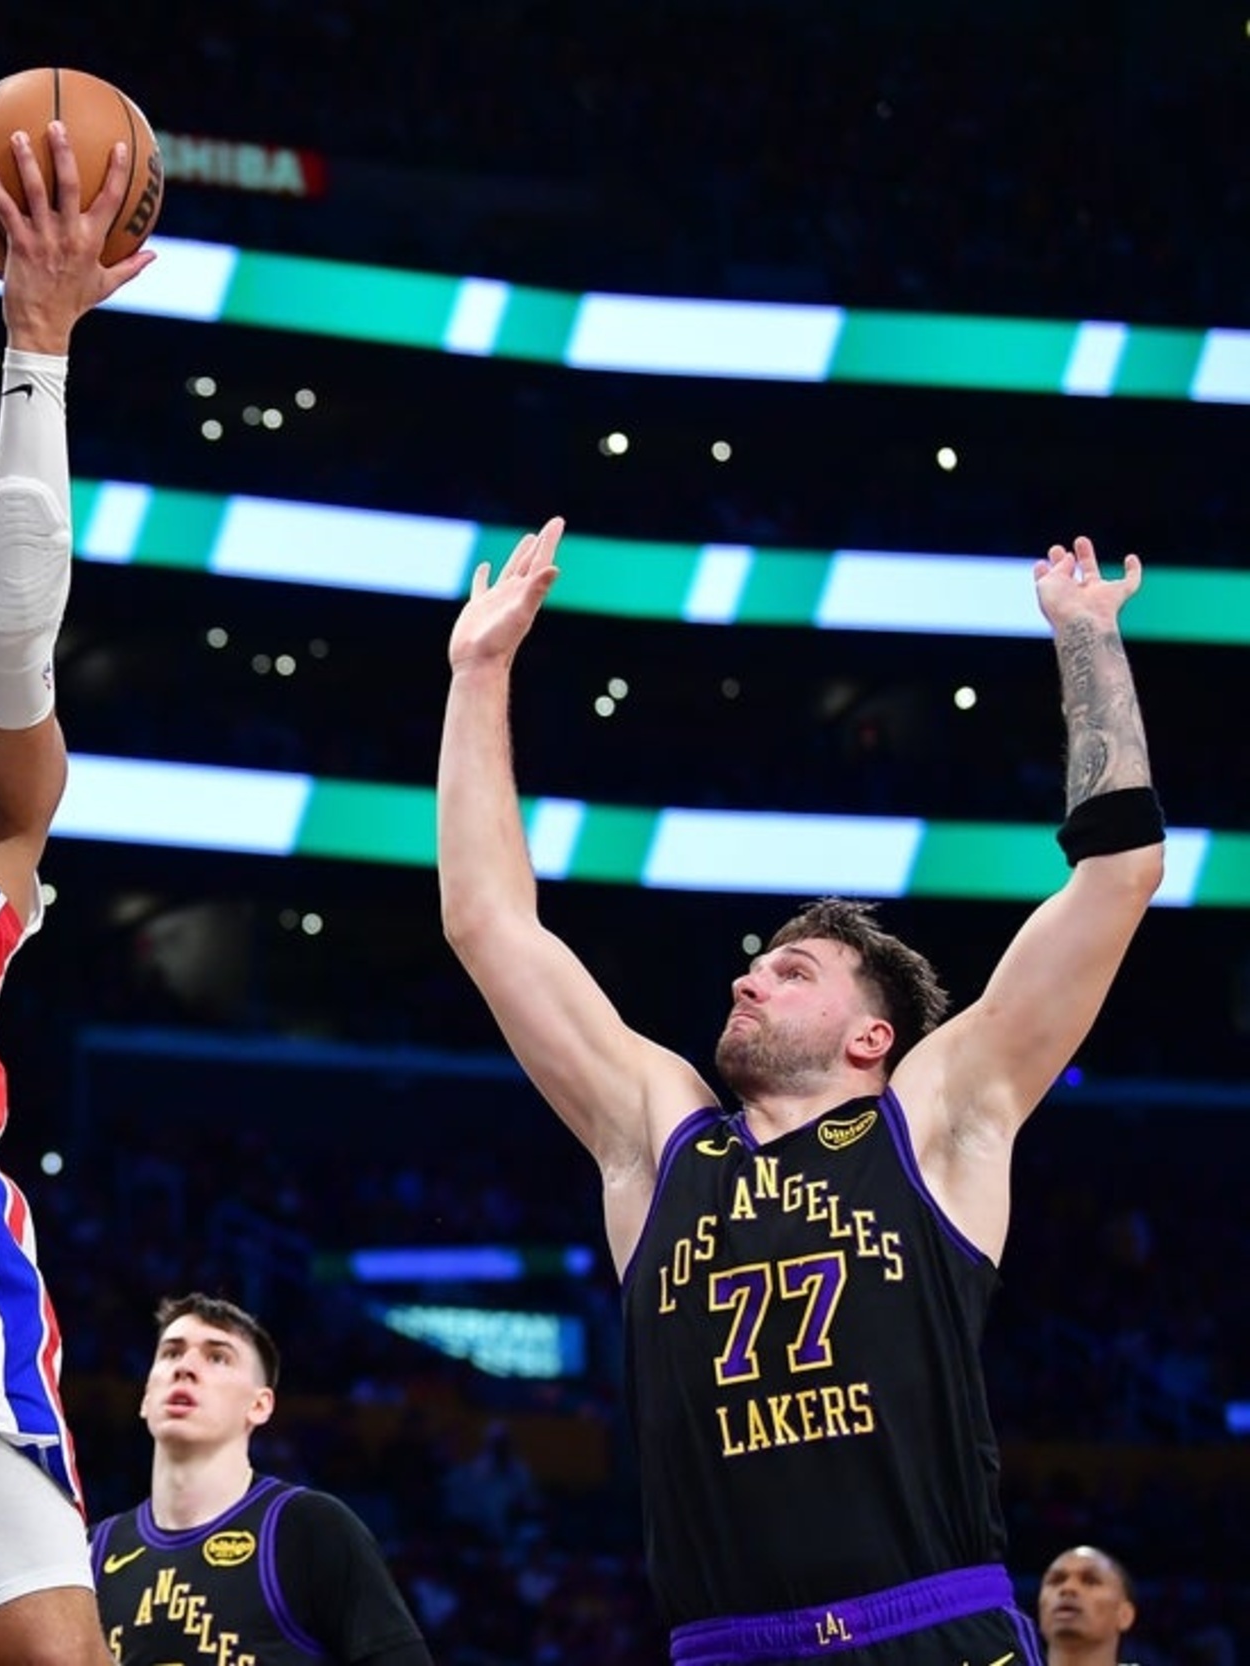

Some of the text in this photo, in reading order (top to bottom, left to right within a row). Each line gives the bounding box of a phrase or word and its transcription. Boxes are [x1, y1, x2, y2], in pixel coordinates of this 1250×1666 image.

[658, 1156, 904, 1314] LOS ANGELES
[708, 1250, 848, 1386] 77
[716, 1382, 875, 1457] LAKERS
[134, 1567, 255, 1666] ANGELE
[815, 1611, 852, 1645] LAL
